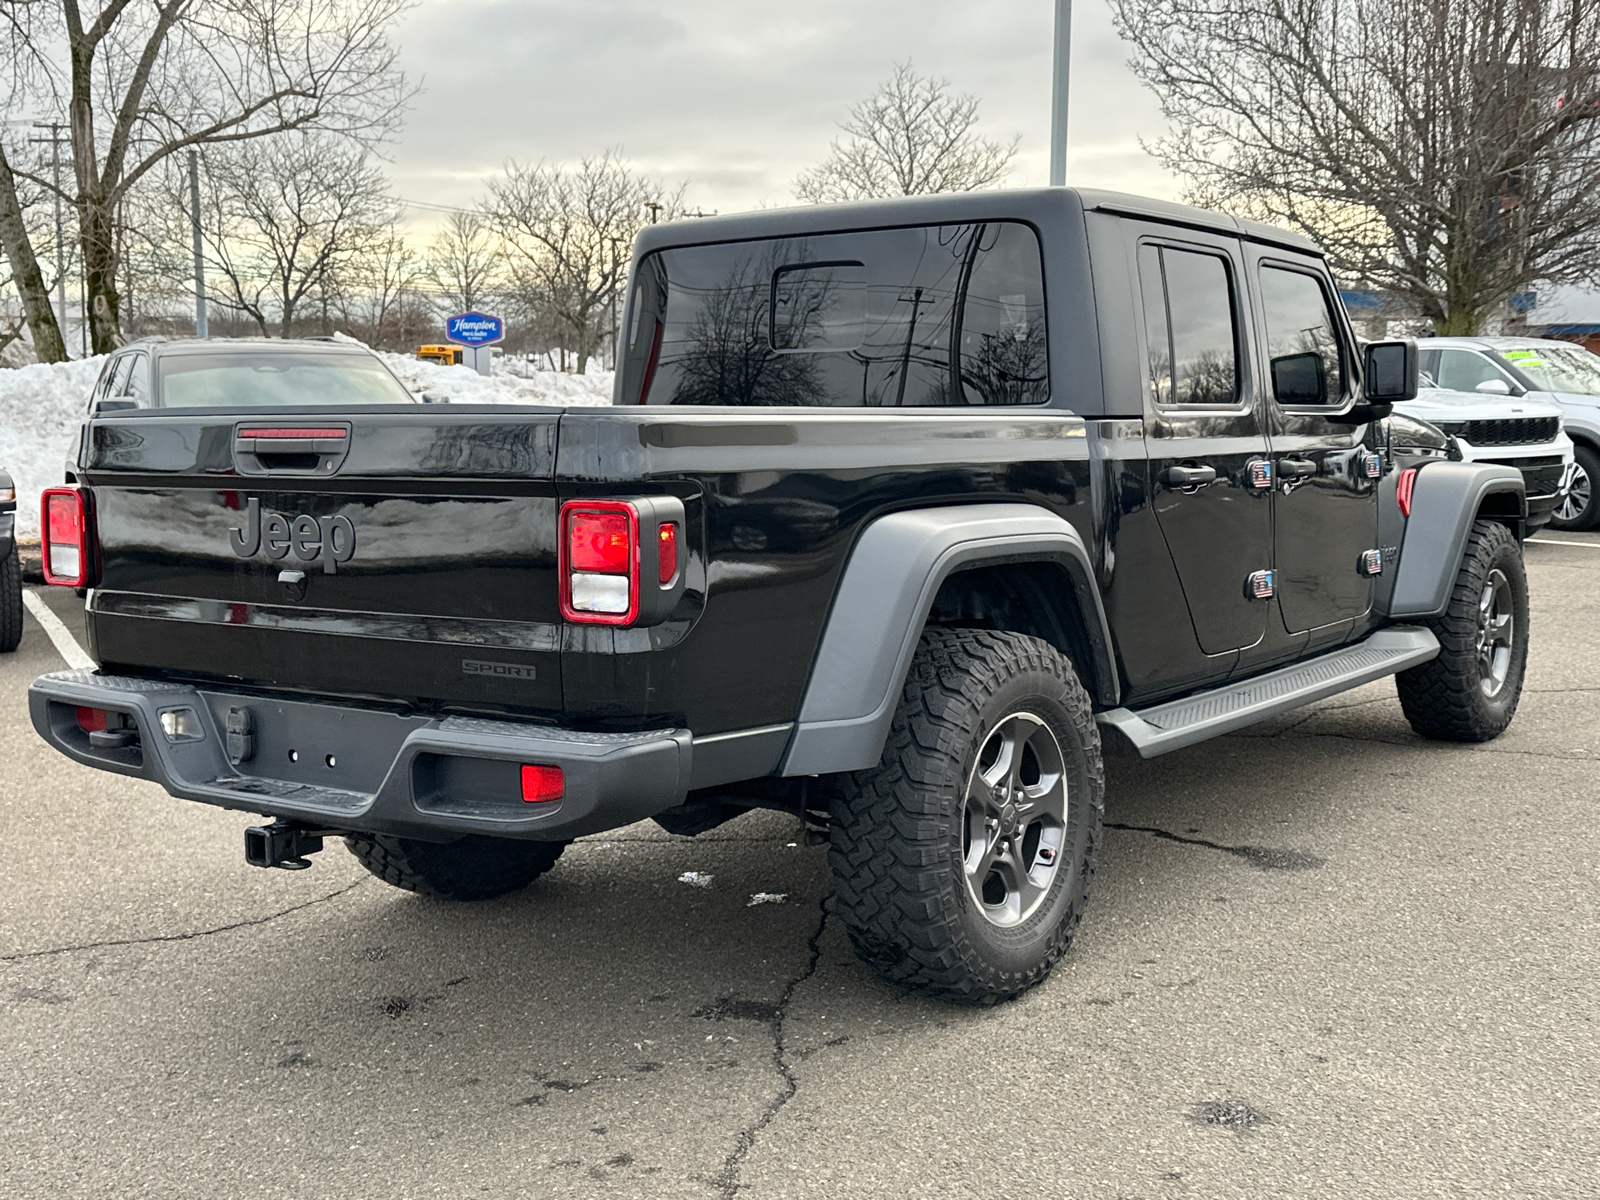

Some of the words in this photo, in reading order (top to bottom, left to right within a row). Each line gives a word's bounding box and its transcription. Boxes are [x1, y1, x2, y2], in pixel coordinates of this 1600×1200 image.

[451, 318, 497, 332] Hampton
[229, 497, 356, 574] Jeep
[464, 661, 536, 677] SPORT
